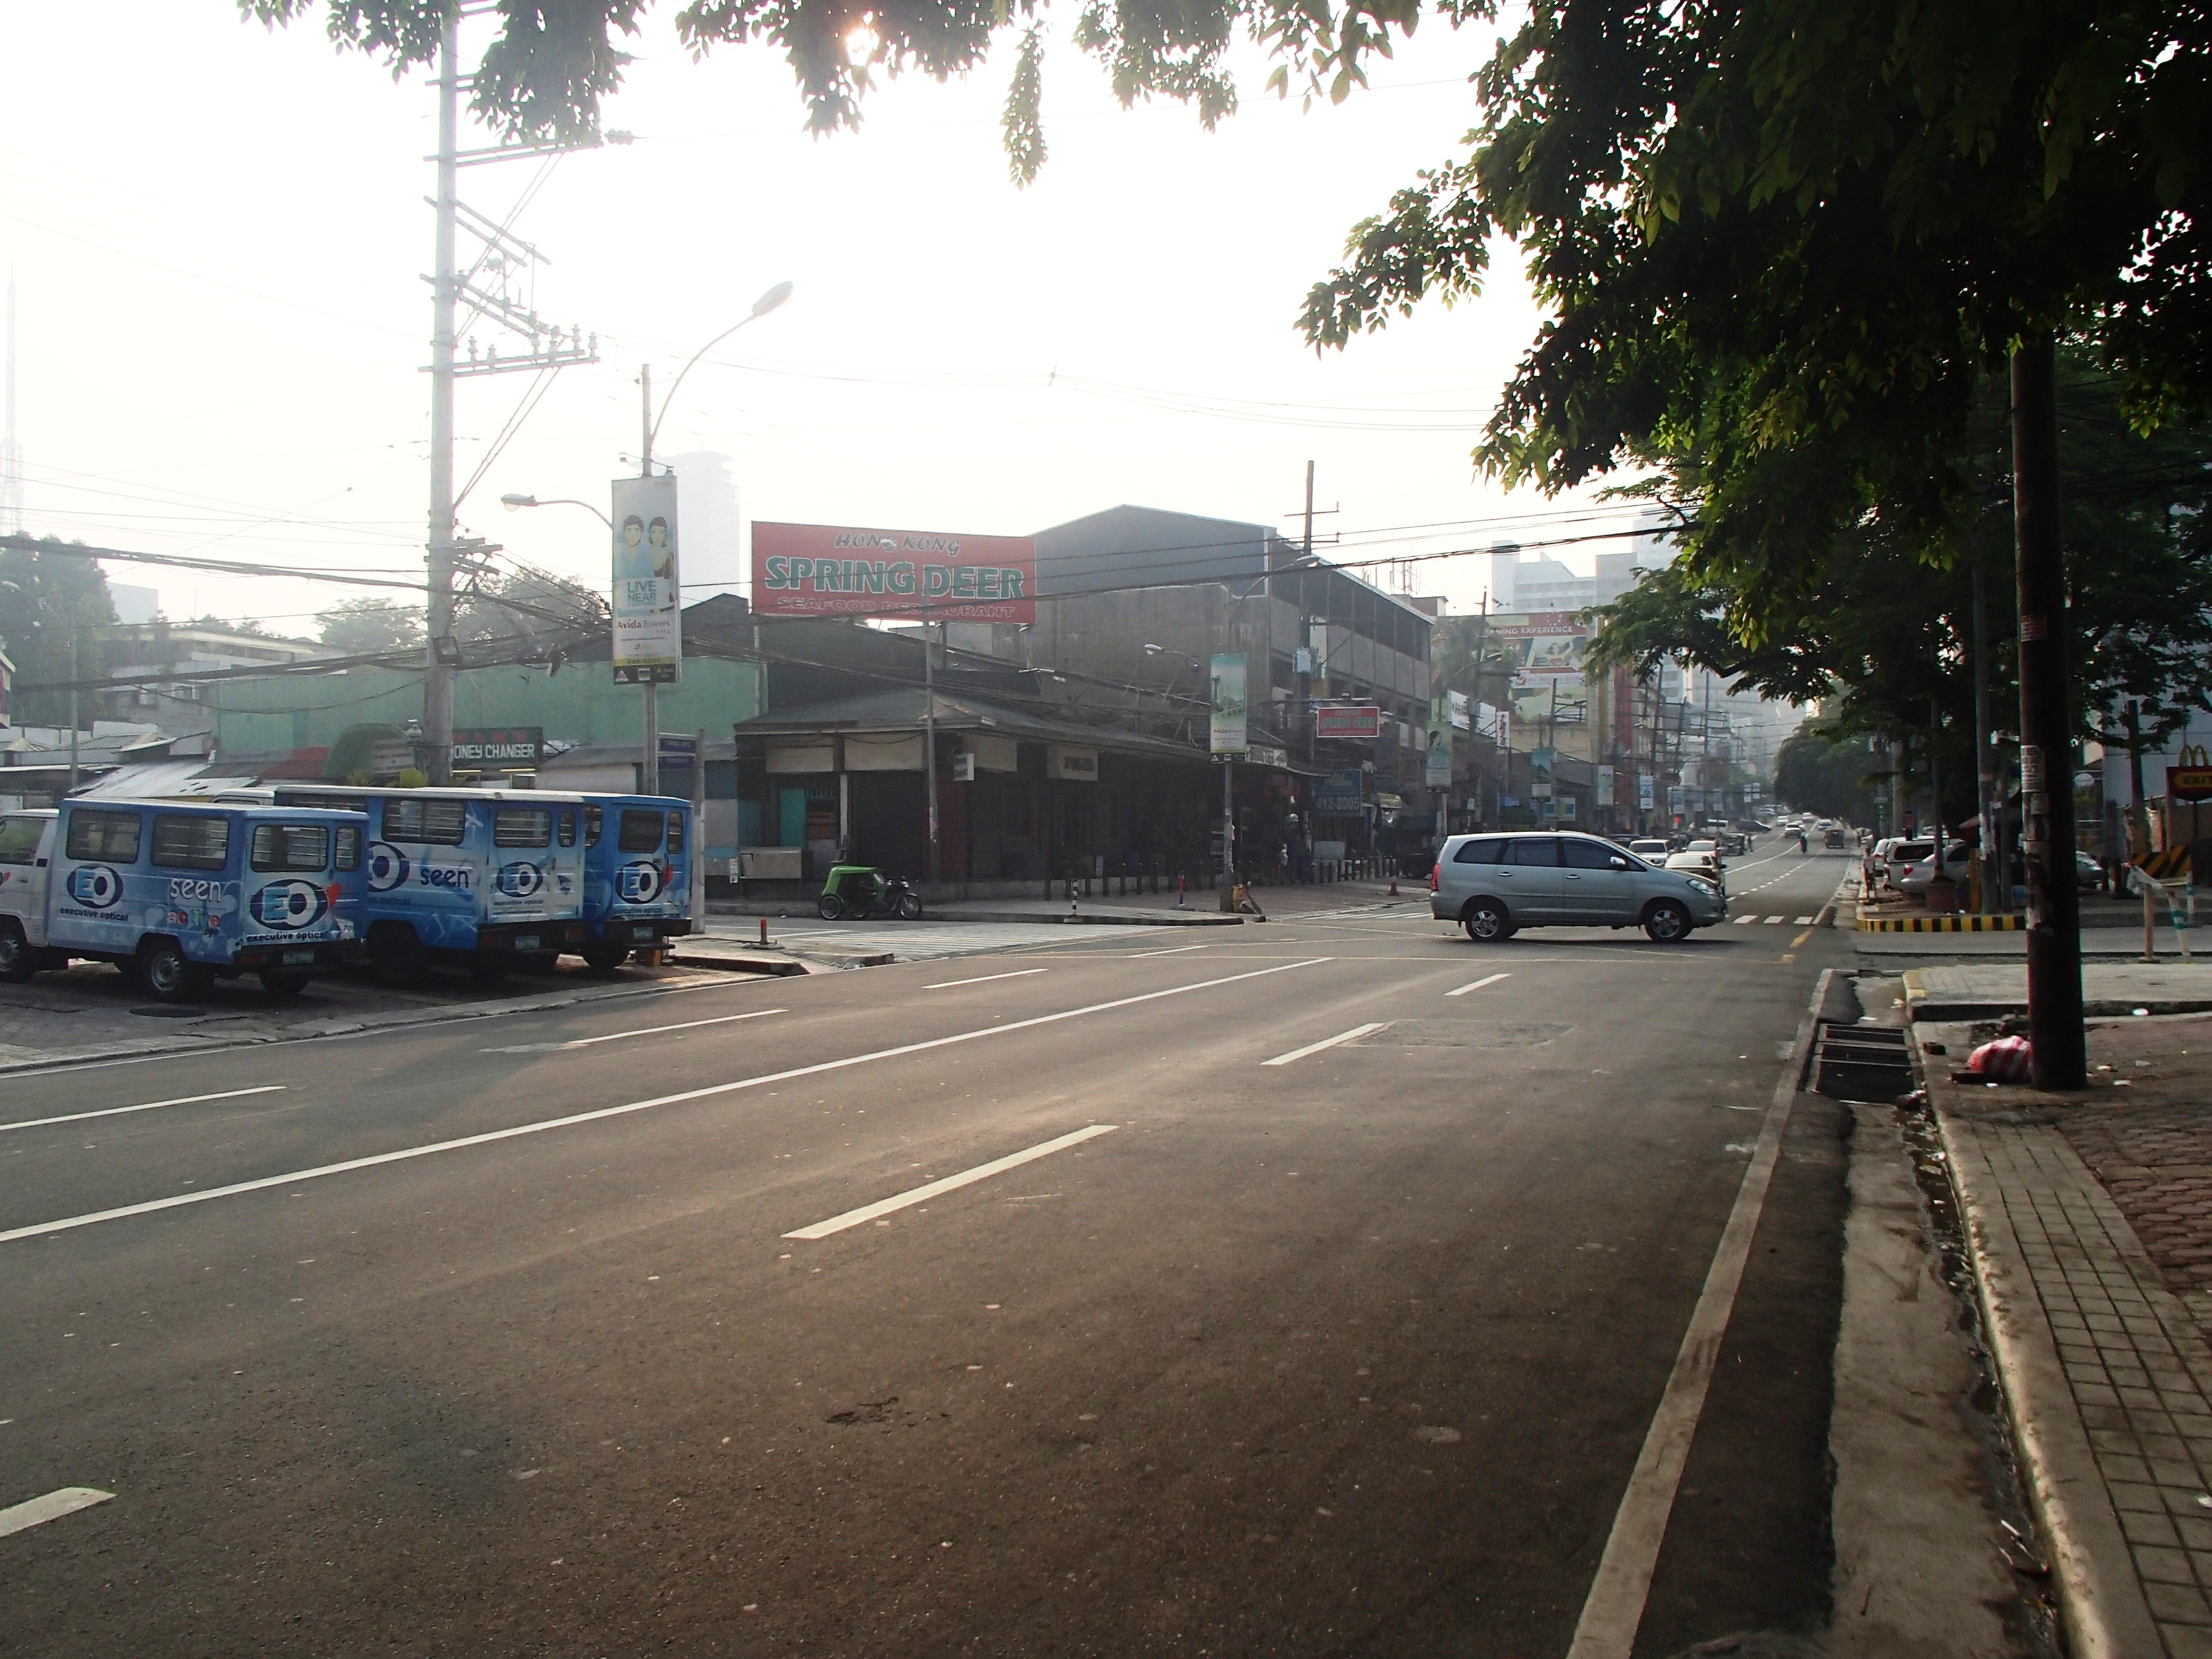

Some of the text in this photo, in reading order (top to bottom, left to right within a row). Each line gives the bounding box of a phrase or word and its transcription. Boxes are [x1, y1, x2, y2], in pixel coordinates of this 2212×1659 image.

[835, 532, 961, 557] HONG KONG
[765, 555, 1025, 599] SPRING DEER
[627, 580, 657, 593] LIVE
[627, 593, 657, 602] NEAR
[777, 596, 877, 612] SEAFOOD
[617, 618, 642, 629] Avida
[454, 744, 535, 759] ONEY CHANGER
[420, 867, 469, 888] seen
[75, 867, 115, 905] EO
[169, 878, 222, 903] seen
[262, 882, 318, 926] EO
[60, 907, 129, 921] executive optical
[246, 929, 328, 942] executive optical
